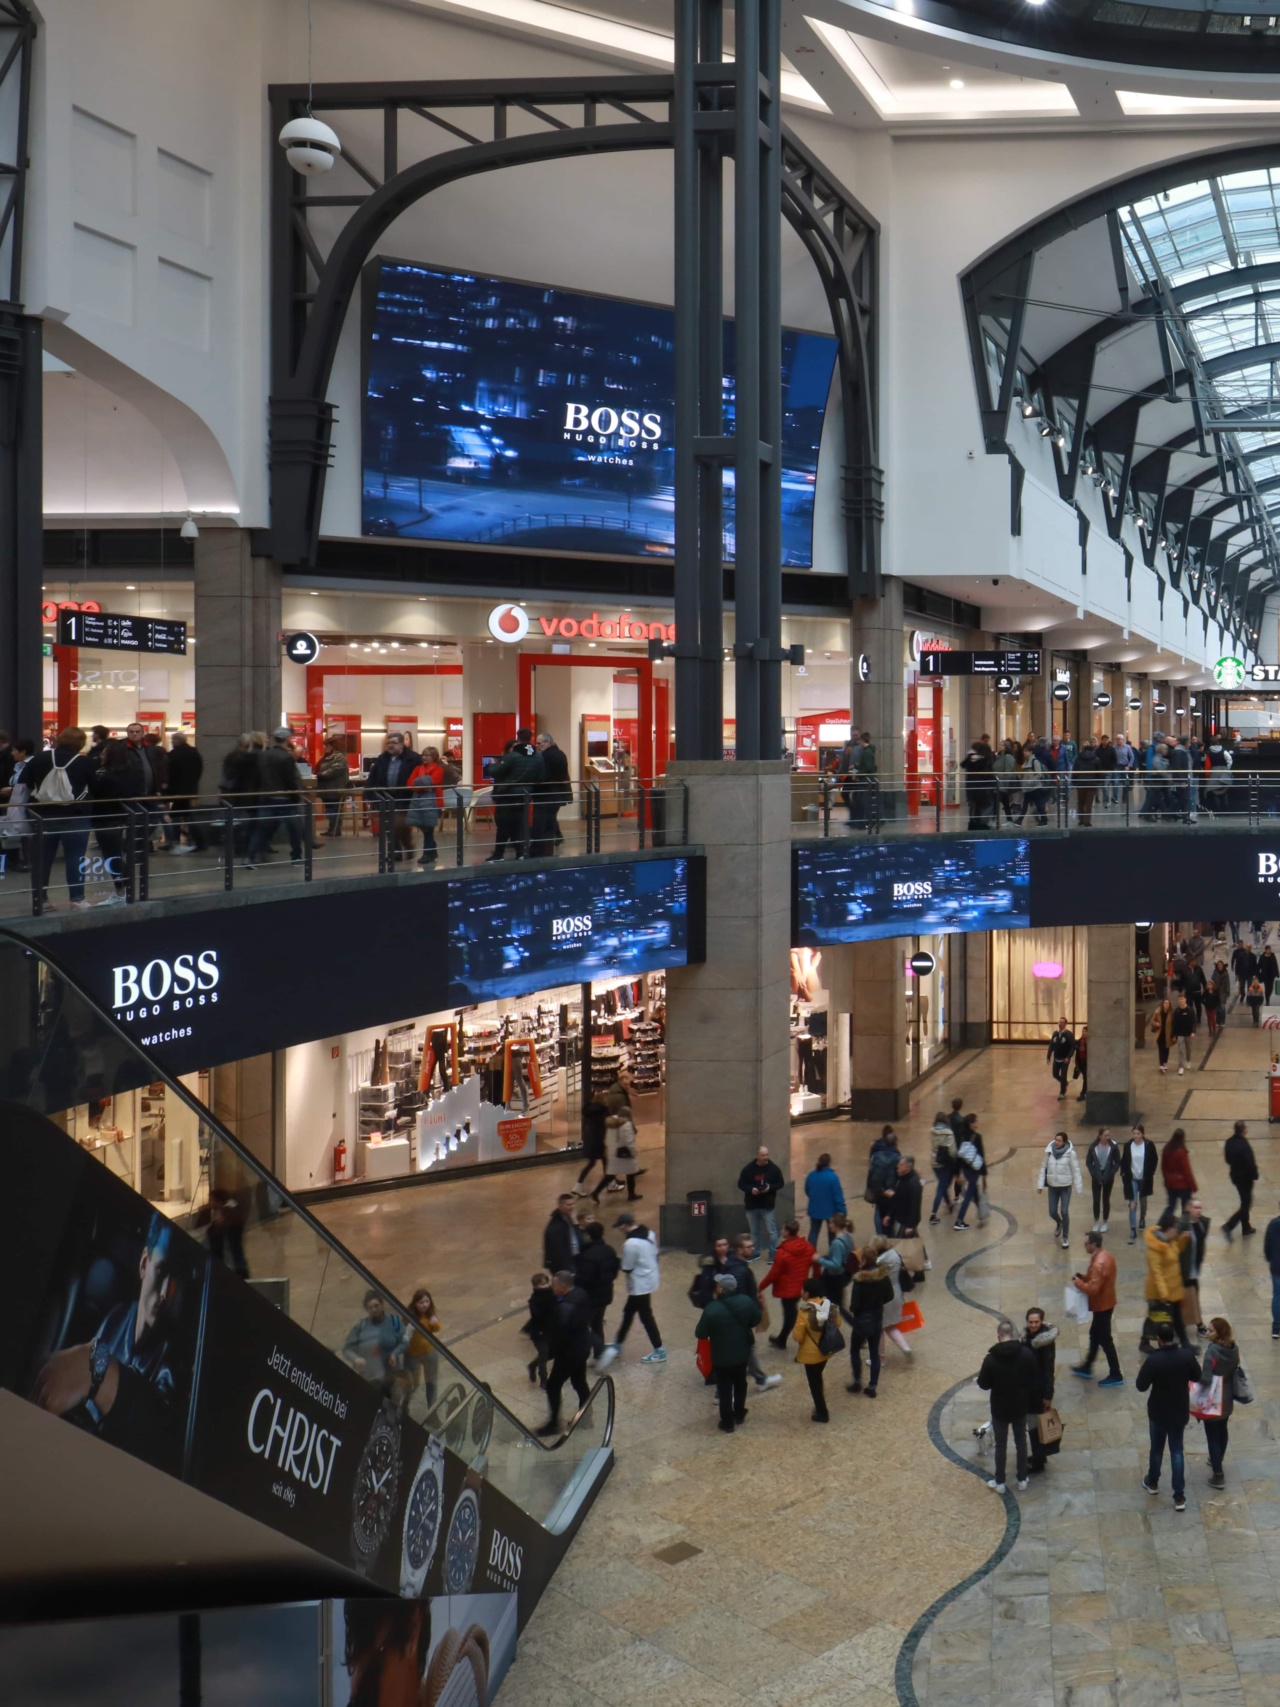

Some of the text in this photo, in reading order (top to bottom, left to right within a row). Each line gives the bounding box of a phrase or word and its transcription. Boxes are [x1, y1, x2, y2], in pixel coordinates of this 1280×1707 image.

[563, 402, 662, 440] BOSS
[563, 432, 659, 450] HUGO BOSS
[587, 455, 634, 466] watches
[66, 616, 76, 640] 1
[925, 655, 934, 672] 1
[893, 881, 933, 896] BOSS
[552, 915, 593, 935] BOSS
[112, 950, 220, 1009] BOSS
[173, 992, 218, 1011] BOSS
[141, 1026, 192, 1046] watches
[267, 1345, 349, 1421] Jetzt entdecken bei
[247, 1388, 342, 1496] CHRIST
[271, 1481, 297, 1508] seit 1863
[488, 1528, 524, 1581] BOSS
[486, 1568, 501, 1585] HUGO
